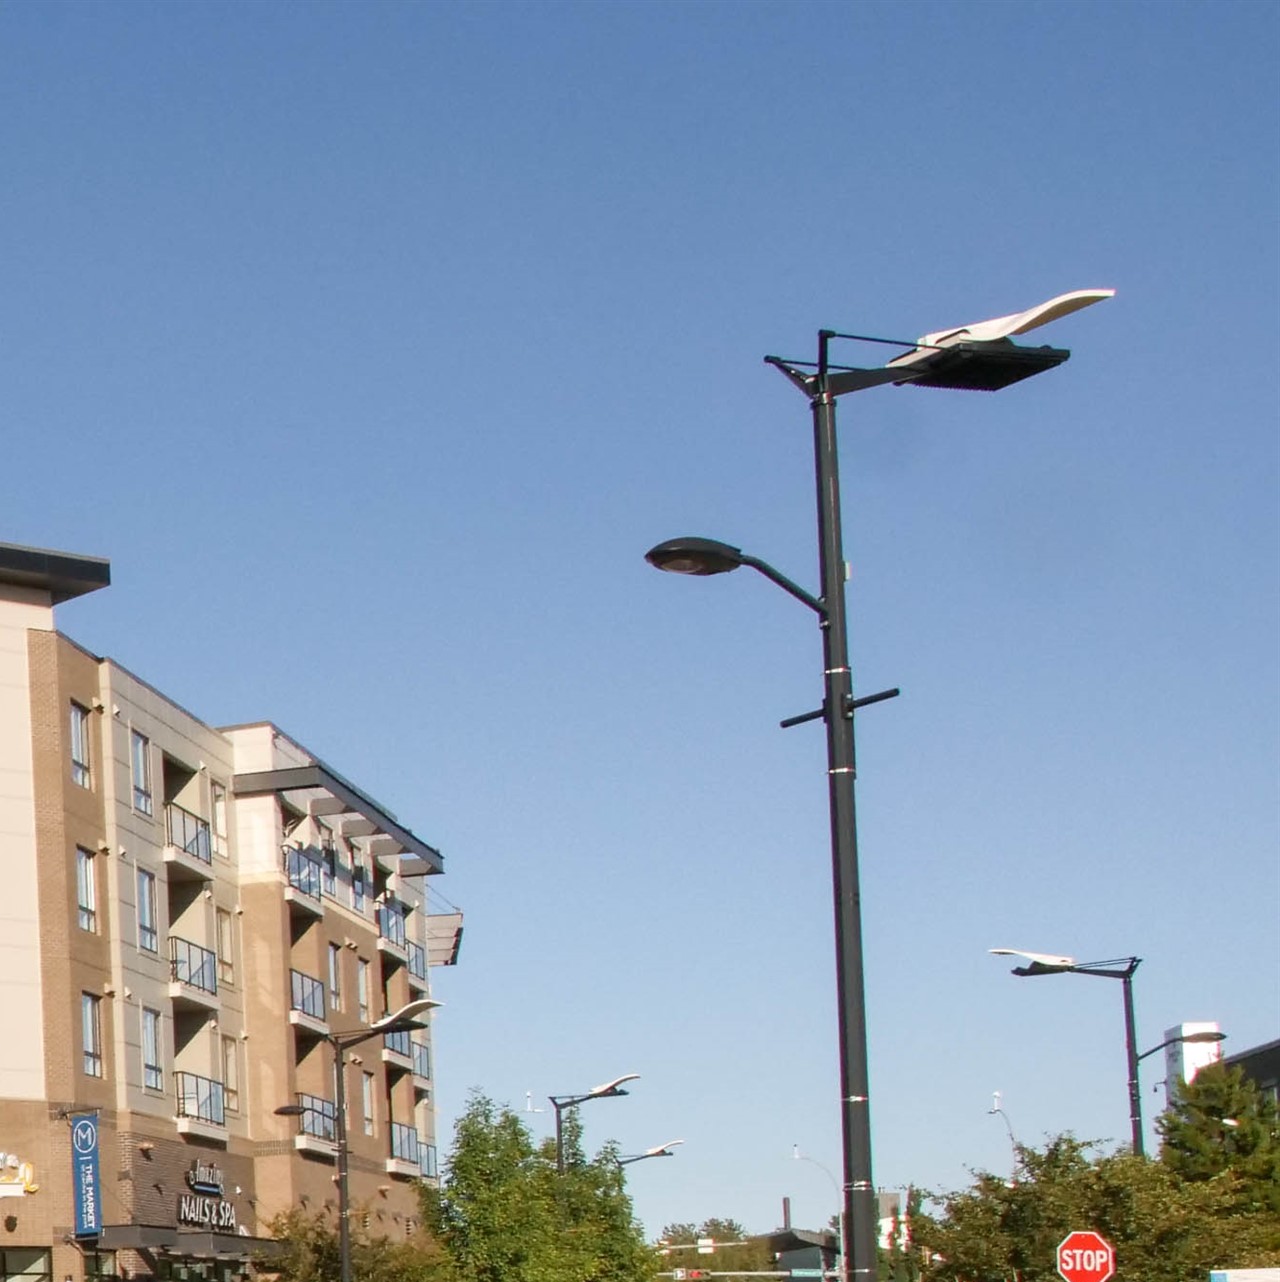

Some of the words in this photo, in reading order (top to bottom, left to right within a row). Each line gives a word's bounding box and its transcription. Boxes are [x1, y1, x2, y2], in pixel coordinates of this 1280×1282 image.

[85, 1164, 93, 1184] THE
[86, 1187, 95, 1229] MARKET
[181, 1195, 209, 1223] NAILS
[211, 1204, 217, 1225] &
[219, 1201, 236, 1227] SPA
[1061, 1249, 1108, 1272] STOP
